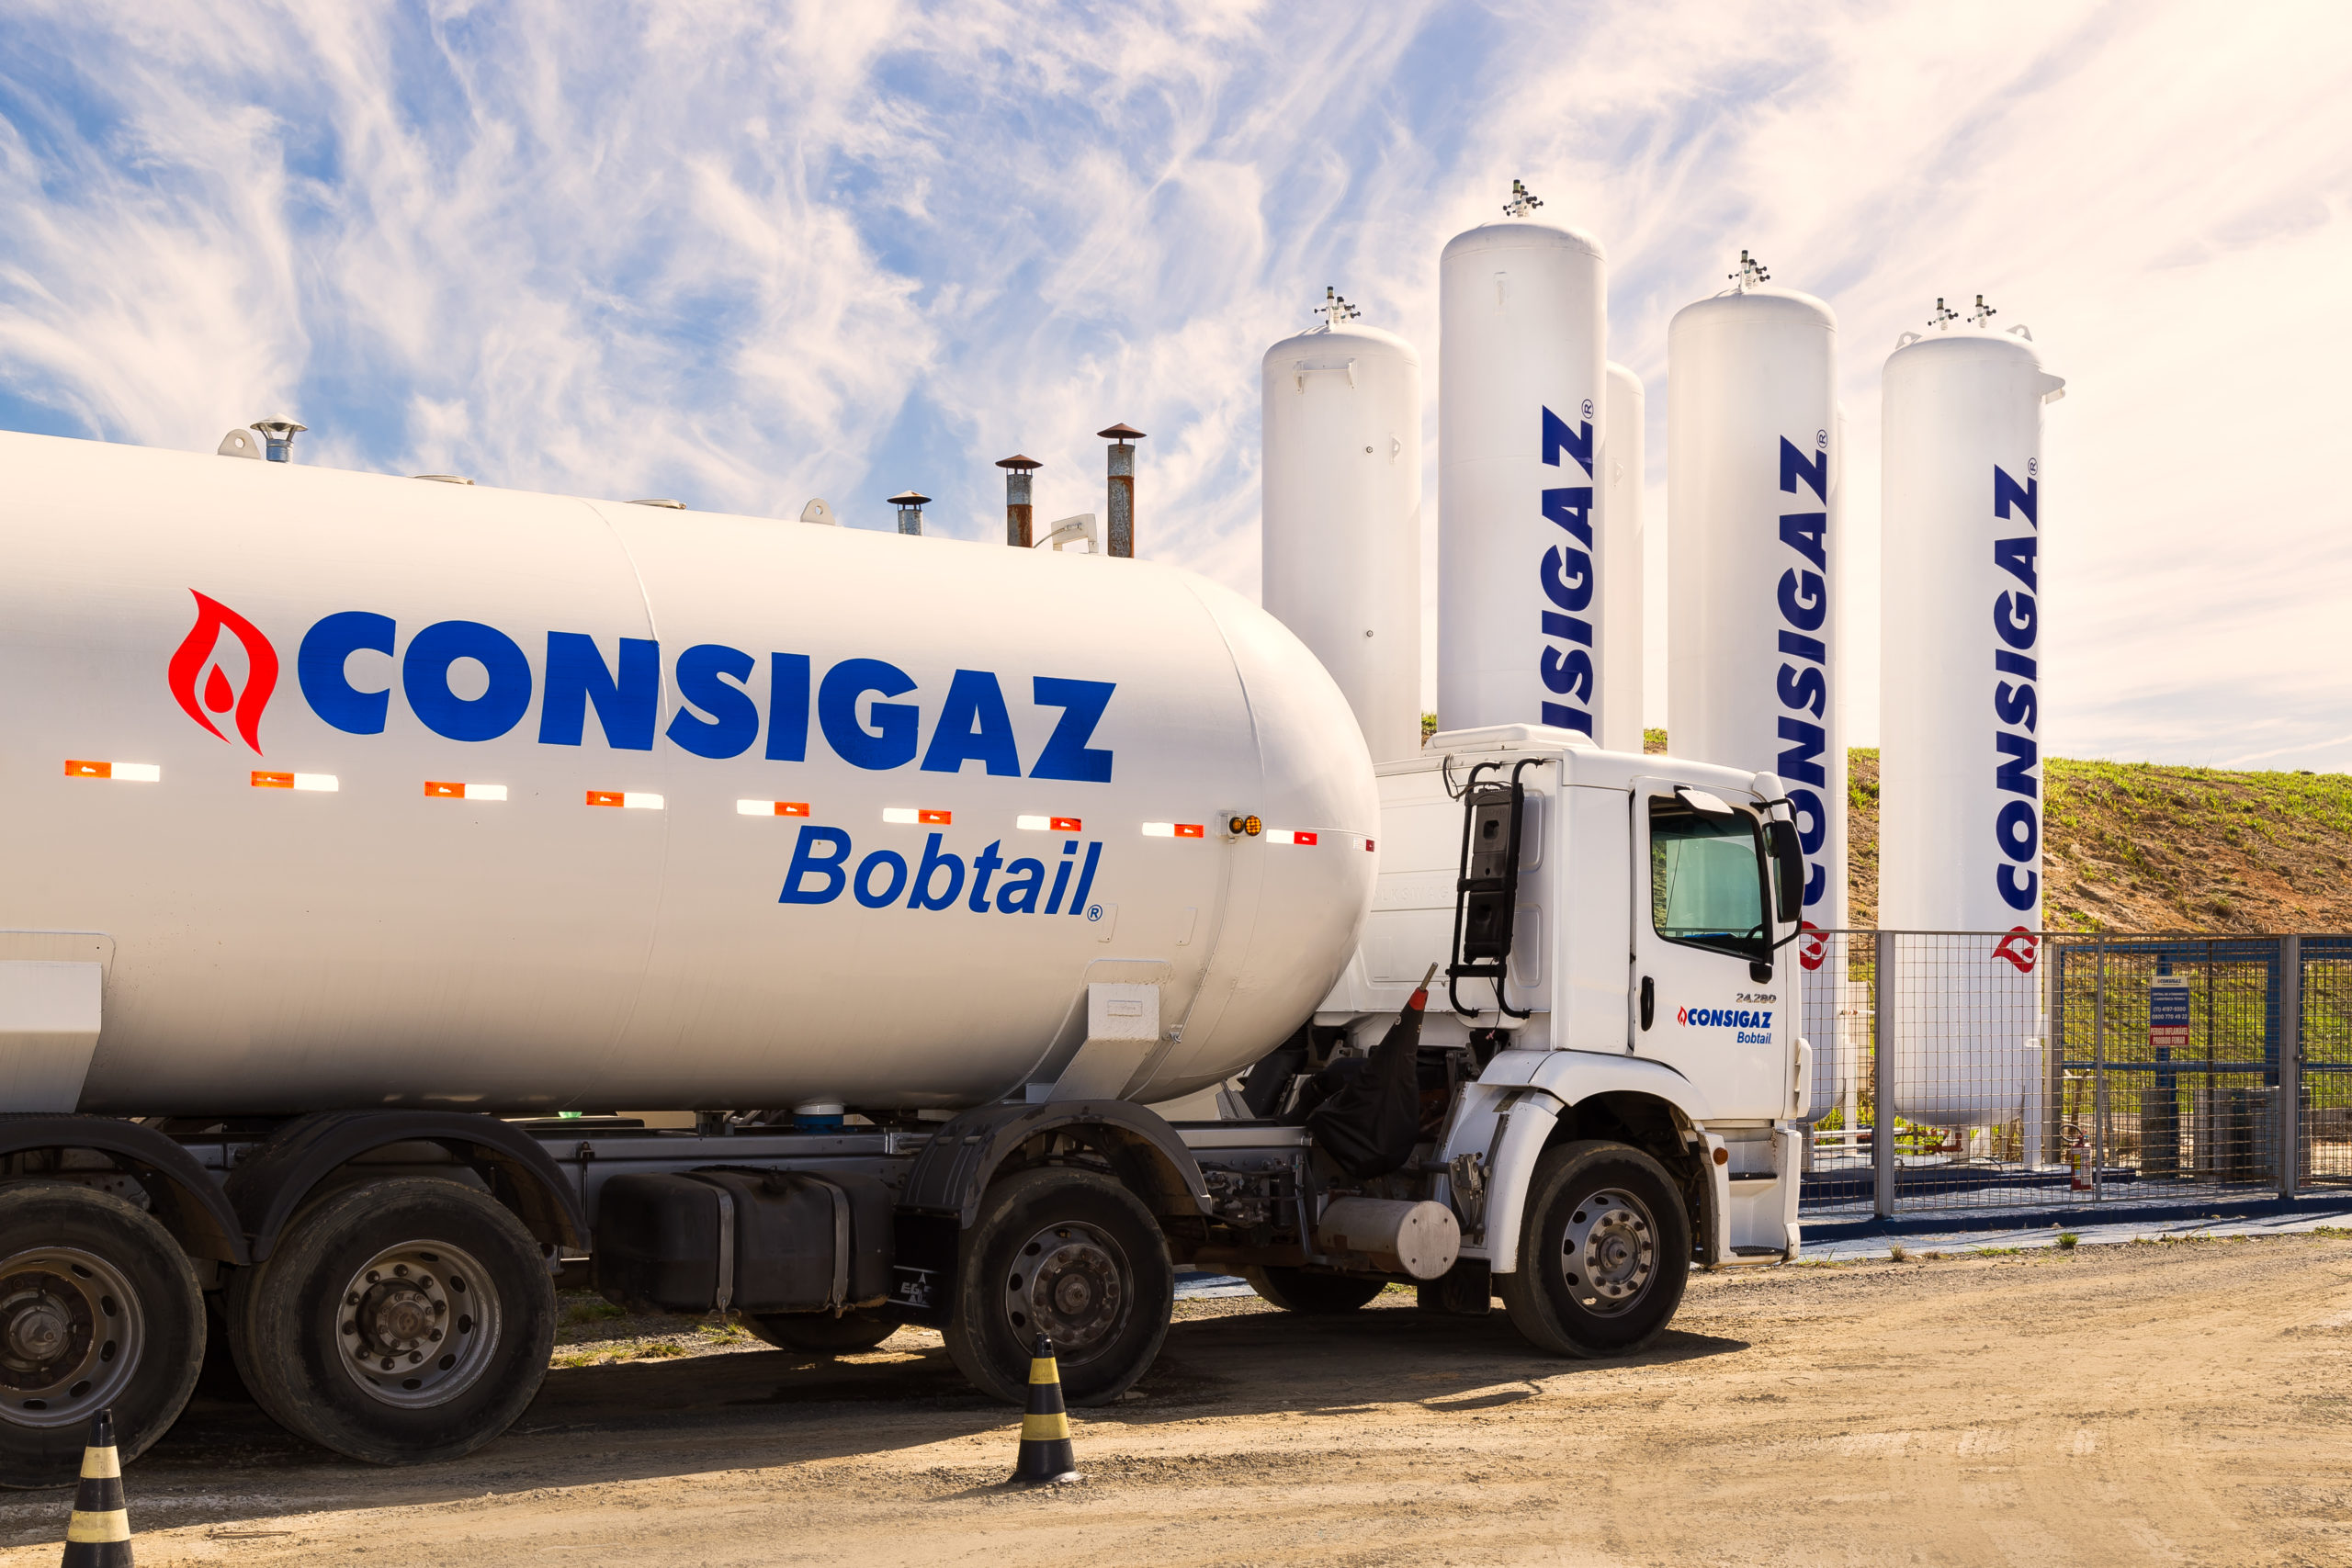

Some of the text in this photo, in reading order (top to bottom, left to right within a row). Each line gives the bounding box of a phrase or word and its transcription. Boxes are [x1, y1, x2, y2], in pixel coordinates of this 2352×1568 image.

[298, 611, 1117, 783] CONSIGAZ
[1994, 464, 2038, 911] CONSIGAZ
[778, 825, 1102, 916] Bobtail
[1688, 1009, 1772, 1028] CONSIGAZ
[1736, 993, 1776, 1003] 24.280
[1736, 1032, 1771, 1043] Bobtail
